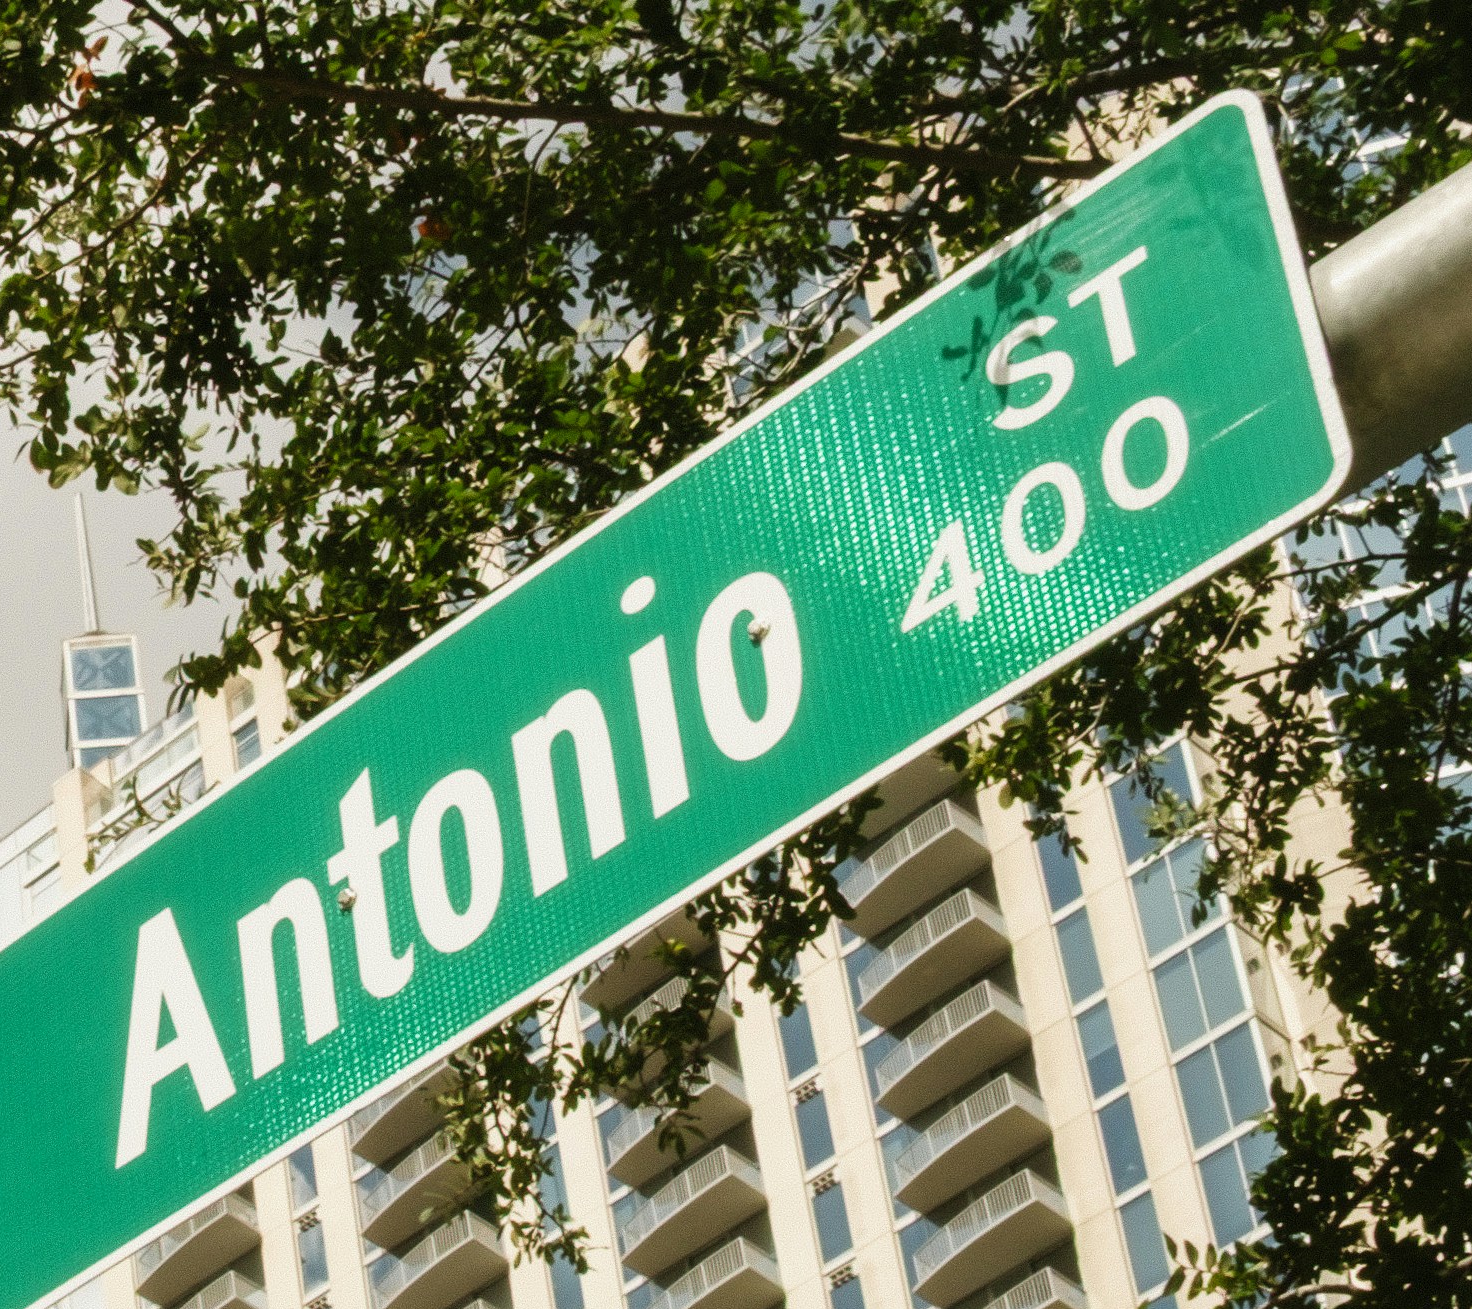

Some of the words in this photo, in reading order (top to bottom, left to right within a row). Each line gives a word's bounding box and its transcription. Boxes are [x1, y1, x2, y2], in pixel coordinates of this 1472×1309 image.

[985, 245, 1148, 431] ST
[900, 395, 1190, 635] 400
[114, 571, 804, 1170] Antonio
